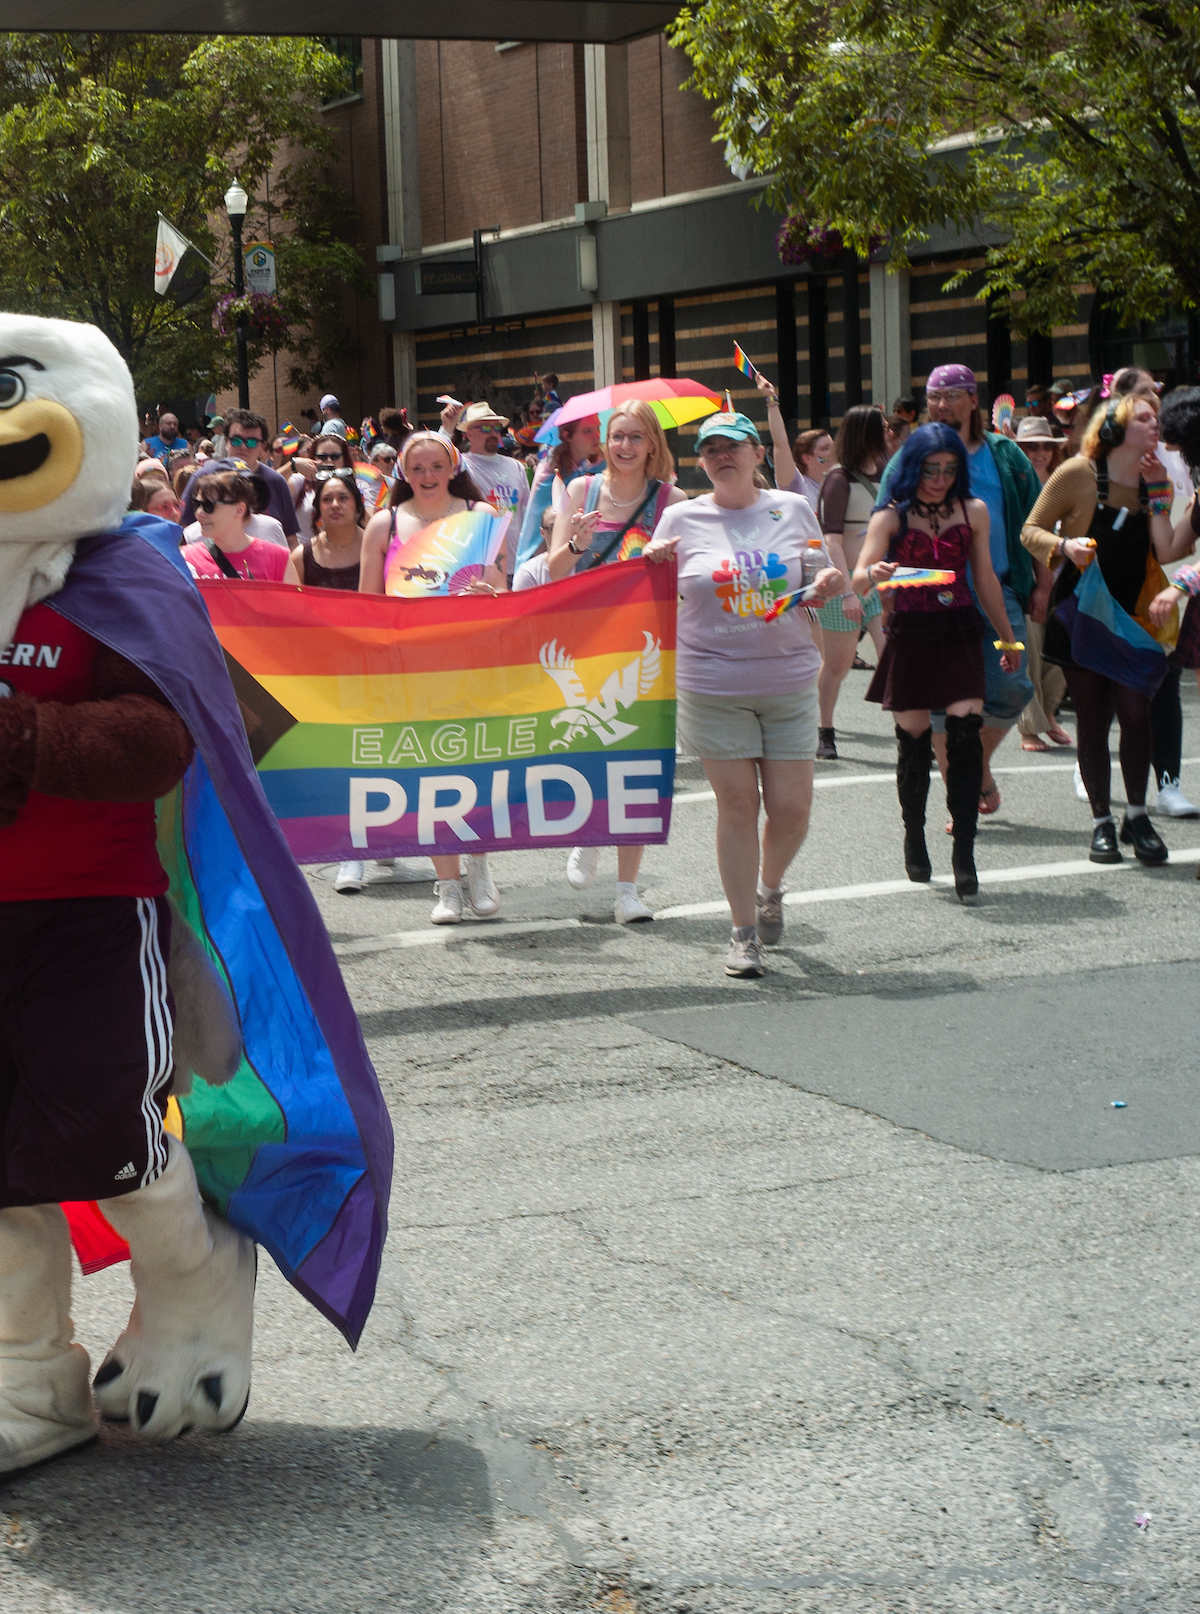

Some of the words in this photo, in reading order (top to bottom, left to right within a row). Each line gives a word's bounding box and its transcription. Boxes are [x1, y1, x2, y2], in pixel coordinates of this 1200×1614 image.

[728, 550, 769, 572] ALLY
[732, 572, 750, 592] IS
[758, 570, 770, 590] A
[728, 590, 775, 616] VERB
[352, 717, 538, 765] EAGLE
[349, 759, 663, 849] PRIDE
